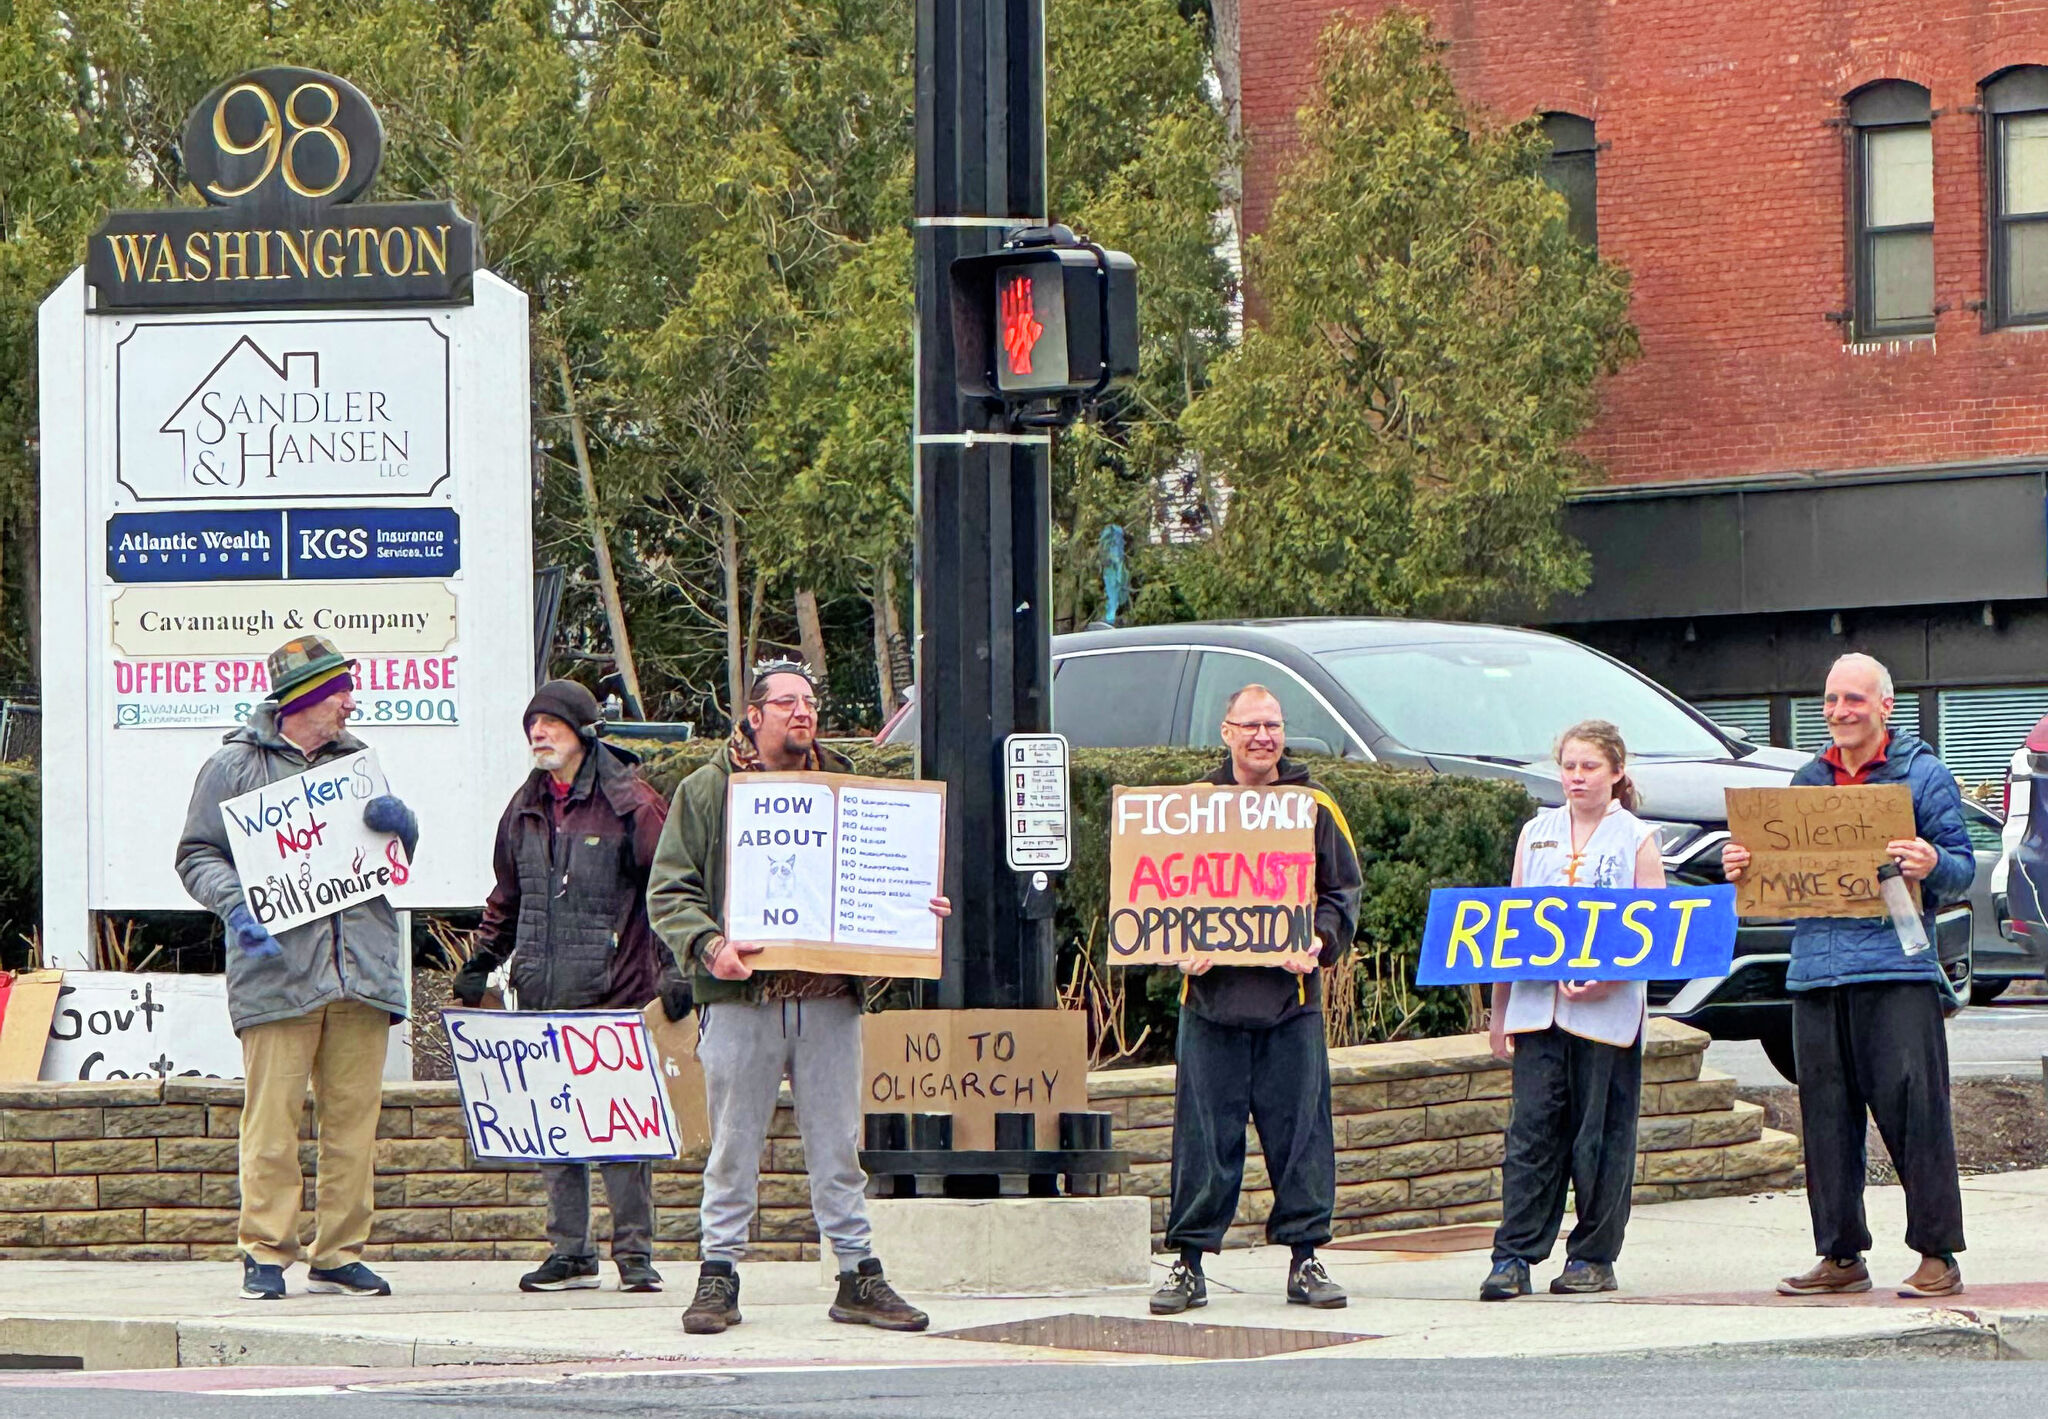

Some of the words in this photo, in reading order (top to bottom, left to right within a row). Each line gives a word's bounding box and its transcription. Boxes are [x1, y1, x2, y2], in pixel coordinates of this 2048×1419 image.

[207, 83, 351, 197] 98
[106, 225, 452, 283] WASHINGTON
[196, 391, 392, 445] SANDLER
[192, 450, 231, 486] &
[236, 423, 409, 488] HANSEN
[380, 463, 409, 477] LLC
[119, 532, 198, 551] Atlantic
[201, 530, 271, 549] Wealth
[299, 528, 368, 559] KGS
[377, 529, 444, 543] Insurance
[425, 546, 444, 557] LLC
[140, 610, 274, 636] Cavanaugh
[284, 609, 304, 629] &
[313, 608, 429, 634] Company
[116, 661, 206, 694] OFFICE
[215, 661, 269, 693] SPA
[370, 657, 456, 691] LEASE
[754, 797, 813, 815] HOW
[1117, 792, 1234, 835] FIGHT
[1239, 789, 1316, 830] BACK
[276, 812, 327, 859] Not
[737, 830, 828, 847] ABOUT
[1128, 851, 1315, 903] AGAINST
[1761, 871, 1833, 904] MAKE
[763, 908, 799, 926] NO
[1110, 904, 1312, 955] OPPRESSION
[1445, 897, 1712, 968] RESIST
[452, 1021, 560, 1093] Support
[562, 1022, 643, 1076] DOJ
[906, 1032, 941, 1063] NO
[968, 1030, 1015, 1062] TO
[551, 1083, 571, 1113] of
[872, 1070, 1059, 1106] OLIGARCHY
[473, 1099, 570, 1156] Rule
[576, 1095, 661, 1143] LAW
